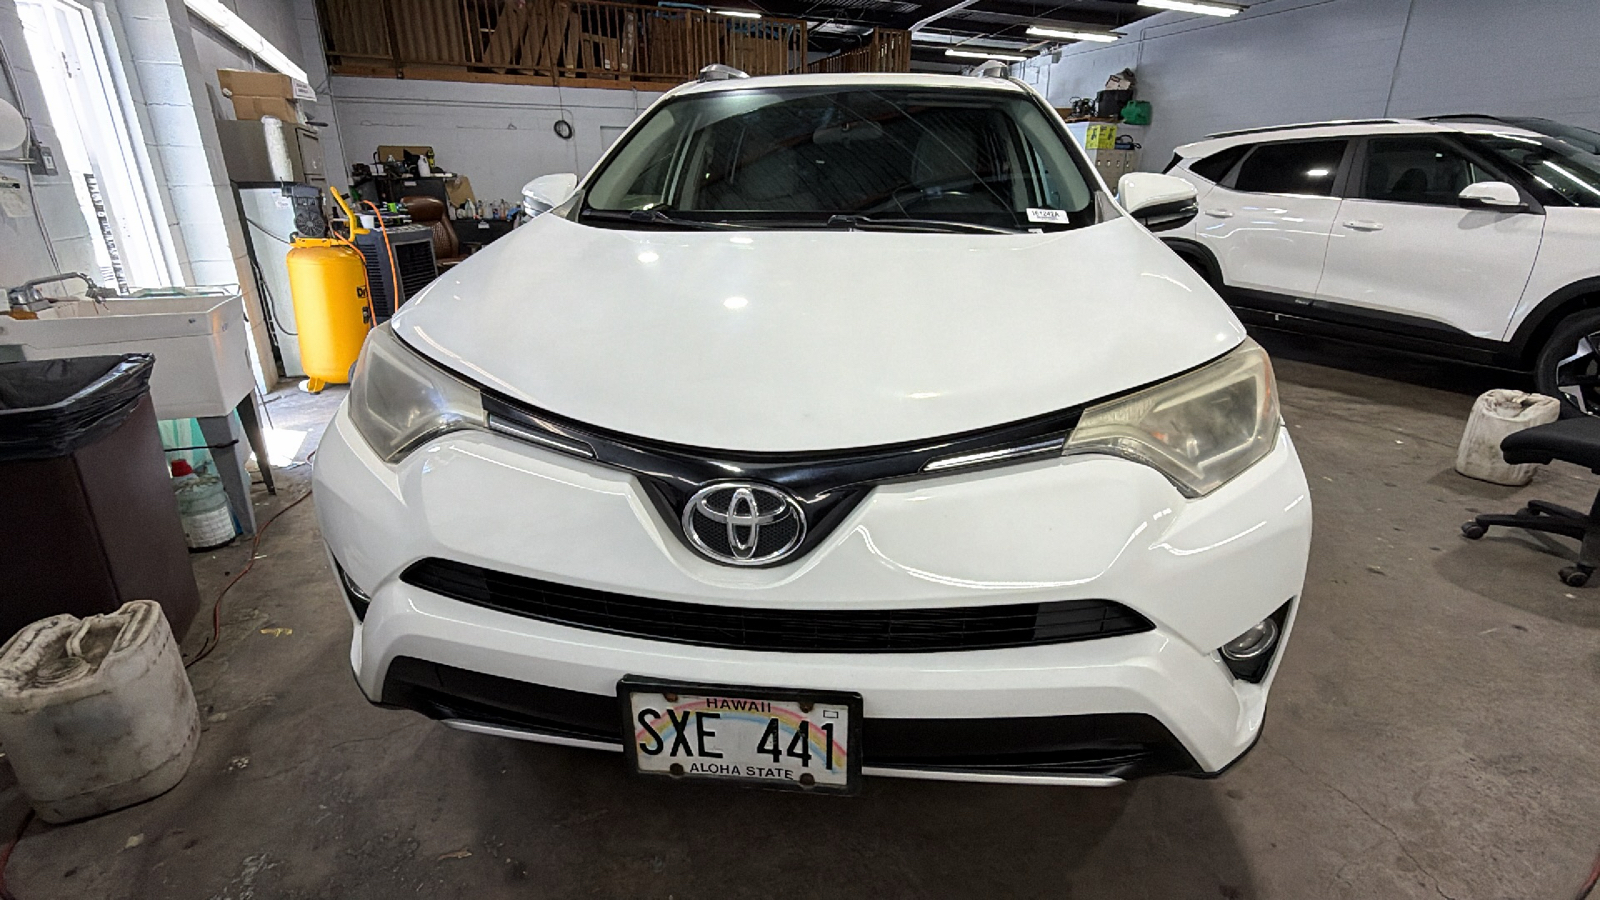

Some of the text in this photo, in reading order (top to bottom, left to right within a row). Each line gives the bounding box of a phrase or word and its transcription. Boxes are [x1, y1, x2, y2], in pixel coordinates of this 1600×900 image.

[706, 697, 771, 713] HAWAII
[638, 708, 834, 770] SXE 441
[689, 762, 794, 780] ALOHA STATE
